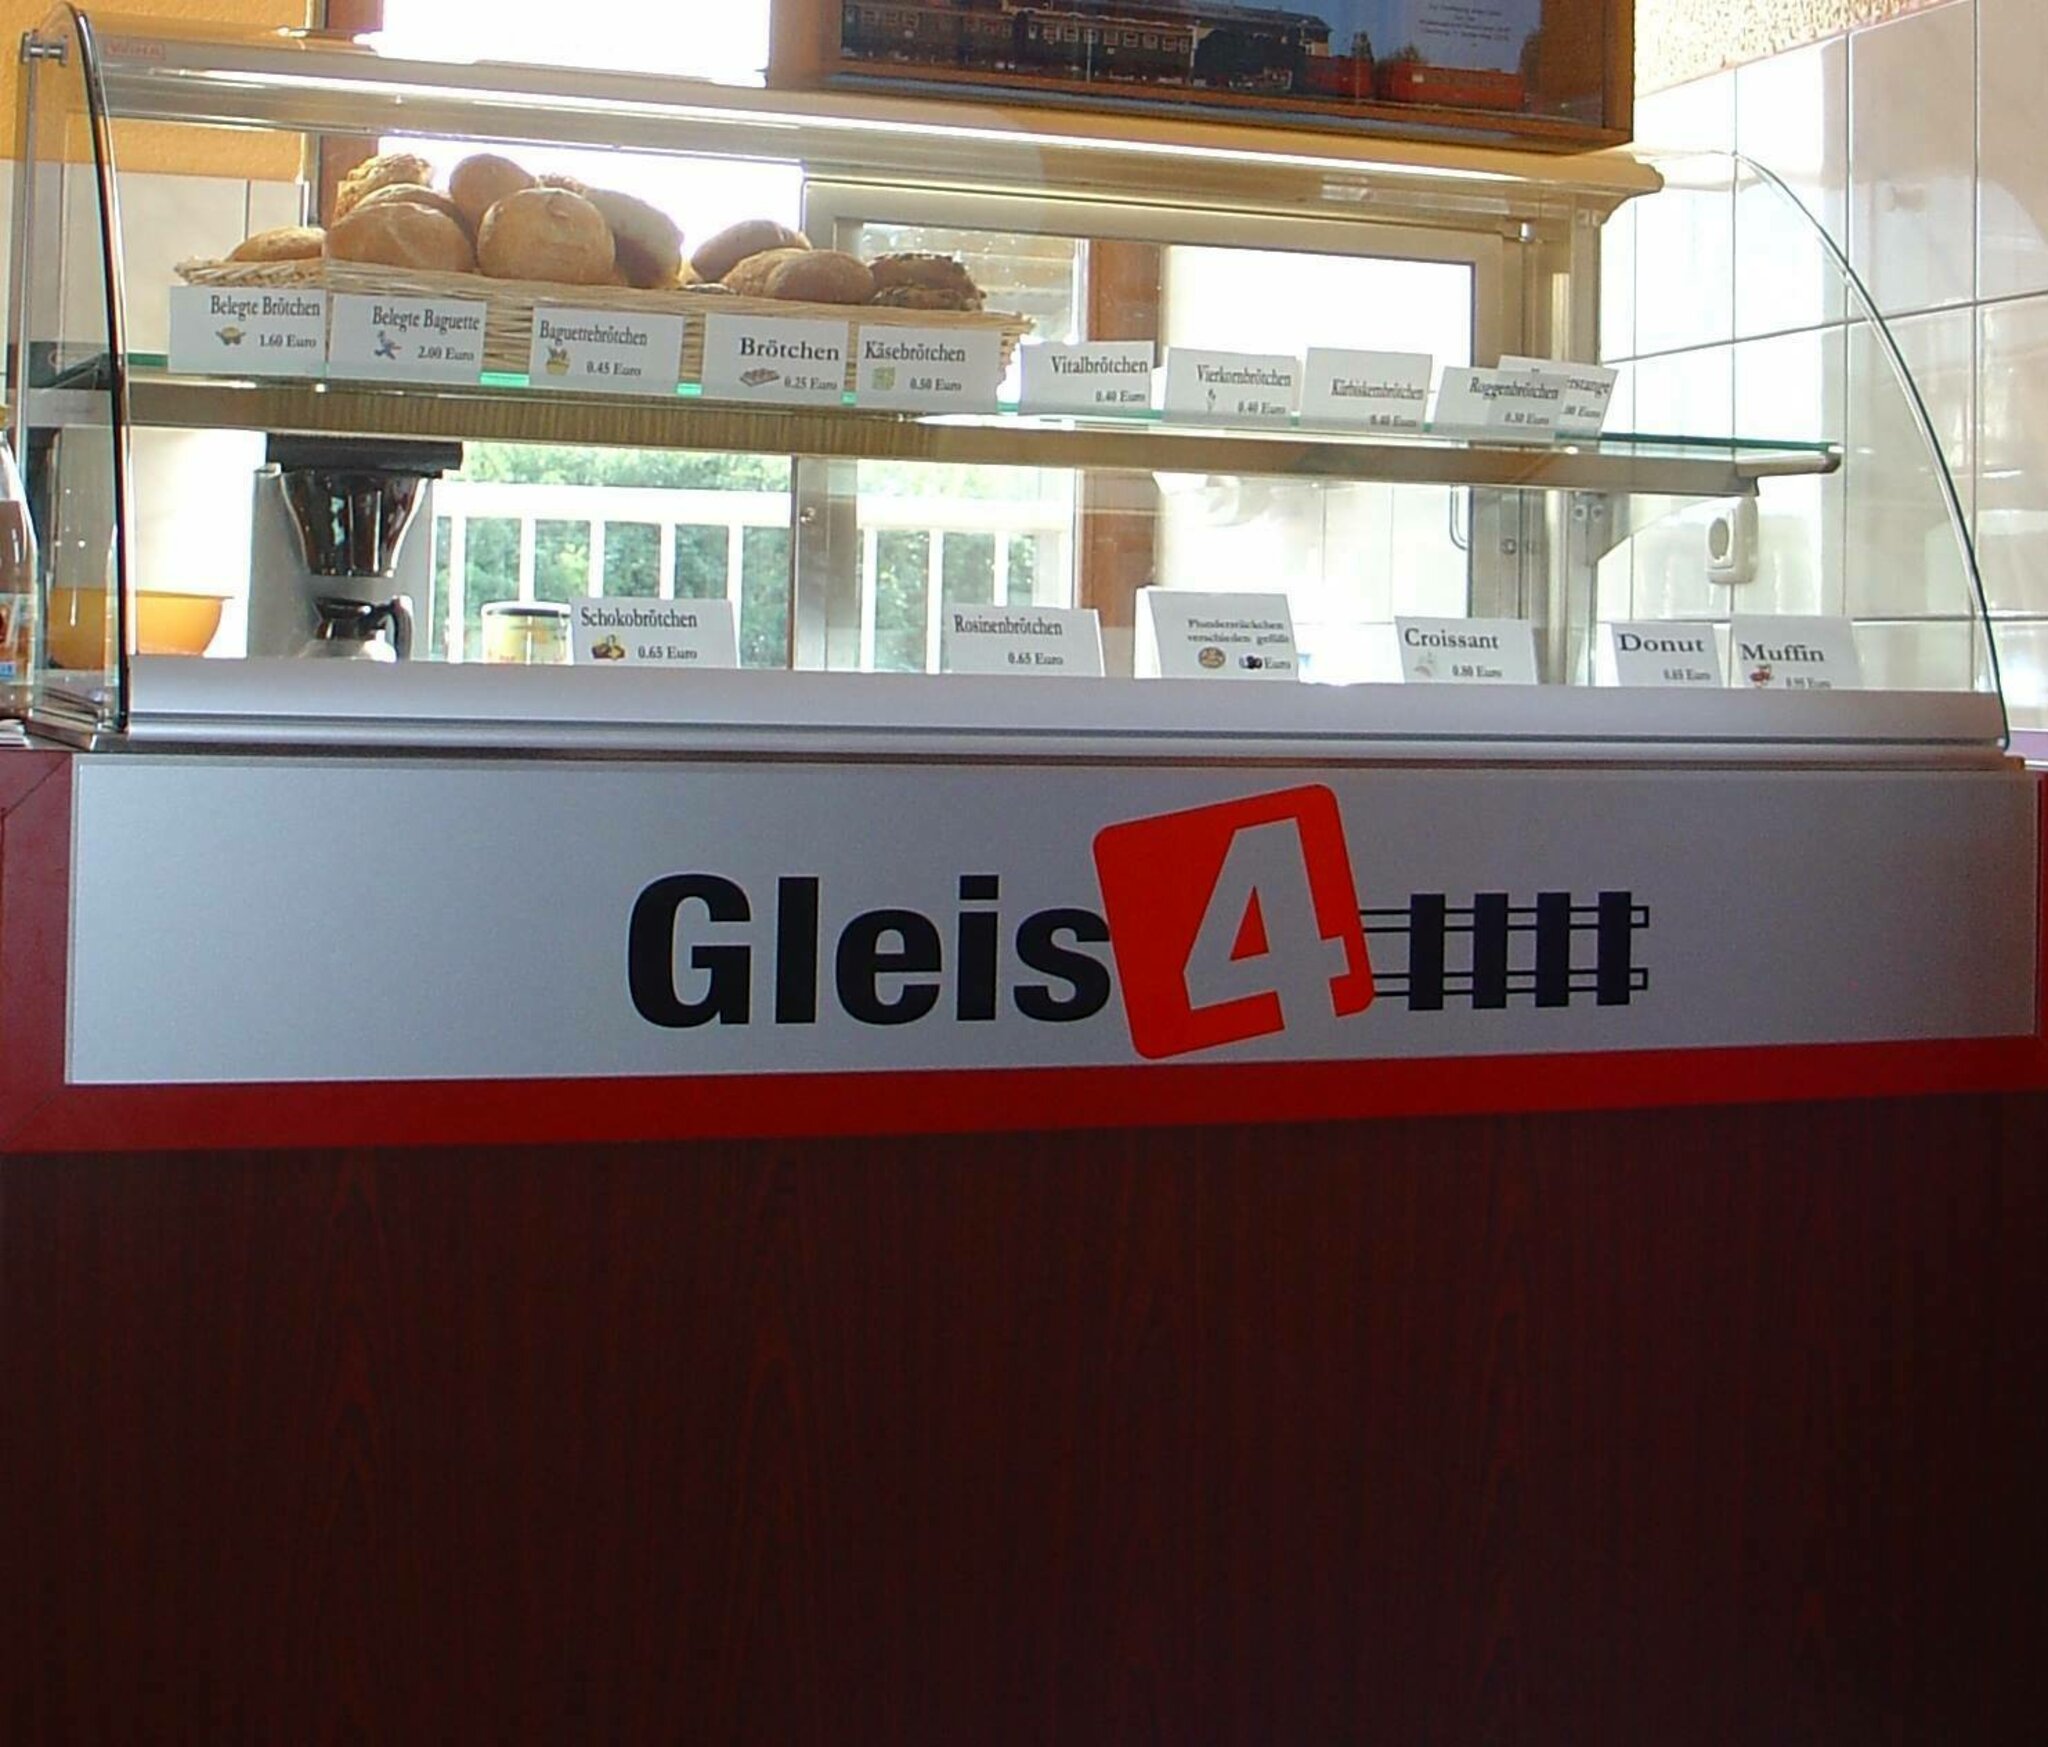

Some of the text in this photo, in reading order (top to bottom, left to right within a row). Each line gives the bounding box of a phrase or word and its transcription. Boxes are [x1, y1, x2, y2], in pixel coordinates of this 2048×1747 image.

[210, 295, 321, 320] Belegte Brötchen
[372, 306, 480, 335] Belegte Baguette
[258, 334, 317, 349] 1.60 Euro
[539, 319, 649, 347] Baguettebrötchen
[417, 345, 475, 361] 2.00 Euro
[739, 336, 840, 362] Brötchen
[864, 340, 966, 362] Käsebrötchen
[586, 361, 642, 377] 0.45 Euro
[1050, 355, 1149, 374] Vitalbrötchen
[784, 377, 838, 391] 0.25 Euro
[909, 377, 962, 392] 0.50 Euro
[1120, 390, 1146, 403] Euro
[1261, 402, 1287, 414] Euro
[580, 606, 698, 628] Schokobrötchen
[953, 614, 1064, 636] Rosinenbrötchen
[1403, 627, 1501, 650] Croissant
[1617, 632, 1706, 653] Donut
[637, 646, 698, 660] 0.65 Euro
[1034, 652, 1064, 666] Euro
[1740, 643, 1826, 663] Muffin
[1476, 665, 1503, 678] Euro
[627, 816, 1349, 1032] Gleis 4
